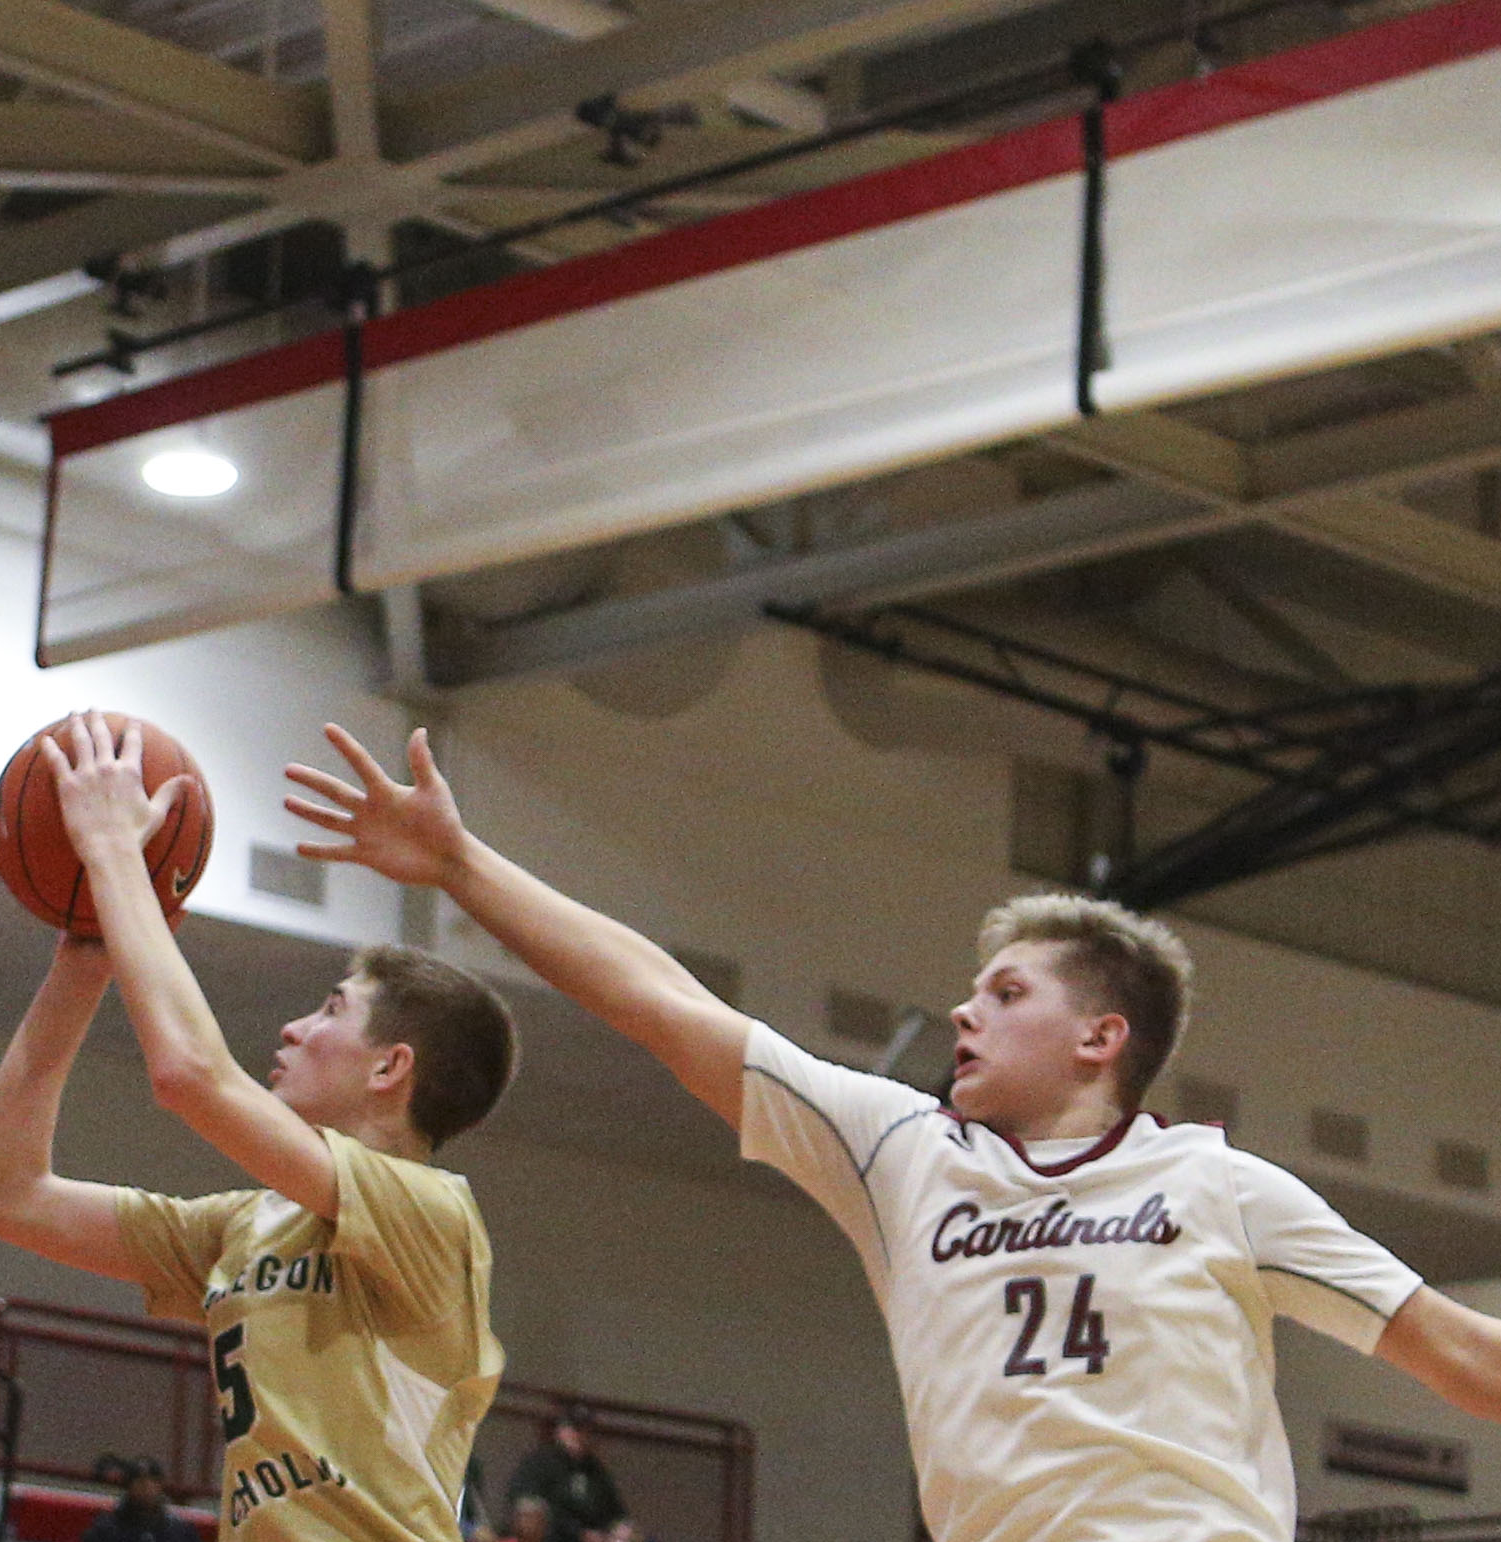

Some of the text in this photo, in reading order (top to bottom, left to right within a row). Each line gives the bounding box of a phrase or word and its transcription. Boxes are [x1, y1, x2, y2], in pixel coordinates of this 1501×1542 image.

[931, 1193, 1181, 1263] Cardinals
[1004, 1273, 1110, 1377] 24
[214, 1323, 257, 1442] 5
